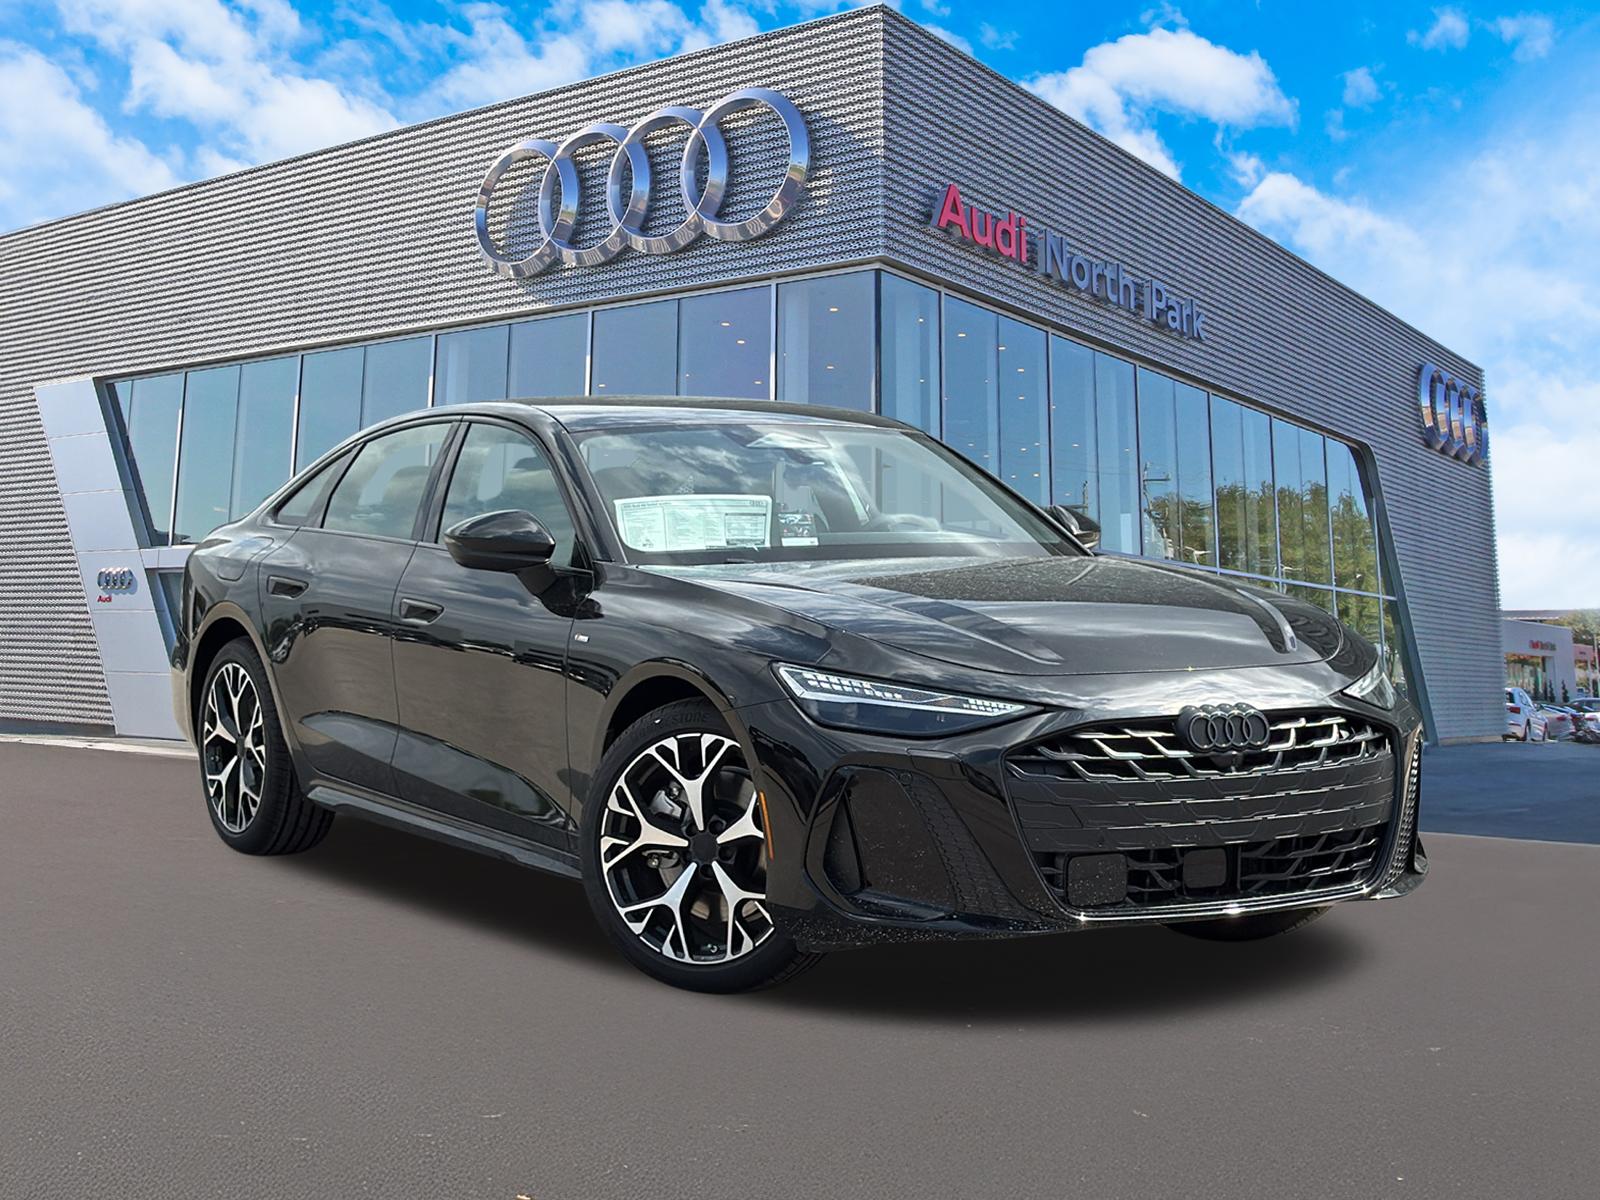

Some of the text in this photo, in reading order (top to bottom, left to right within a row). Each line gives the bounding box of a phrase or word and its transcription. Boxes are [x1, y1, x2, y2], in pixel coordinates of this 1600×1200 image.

[934, 183, 1206, 341] Audi North Park
[97, 595, 112, 603] Audi
